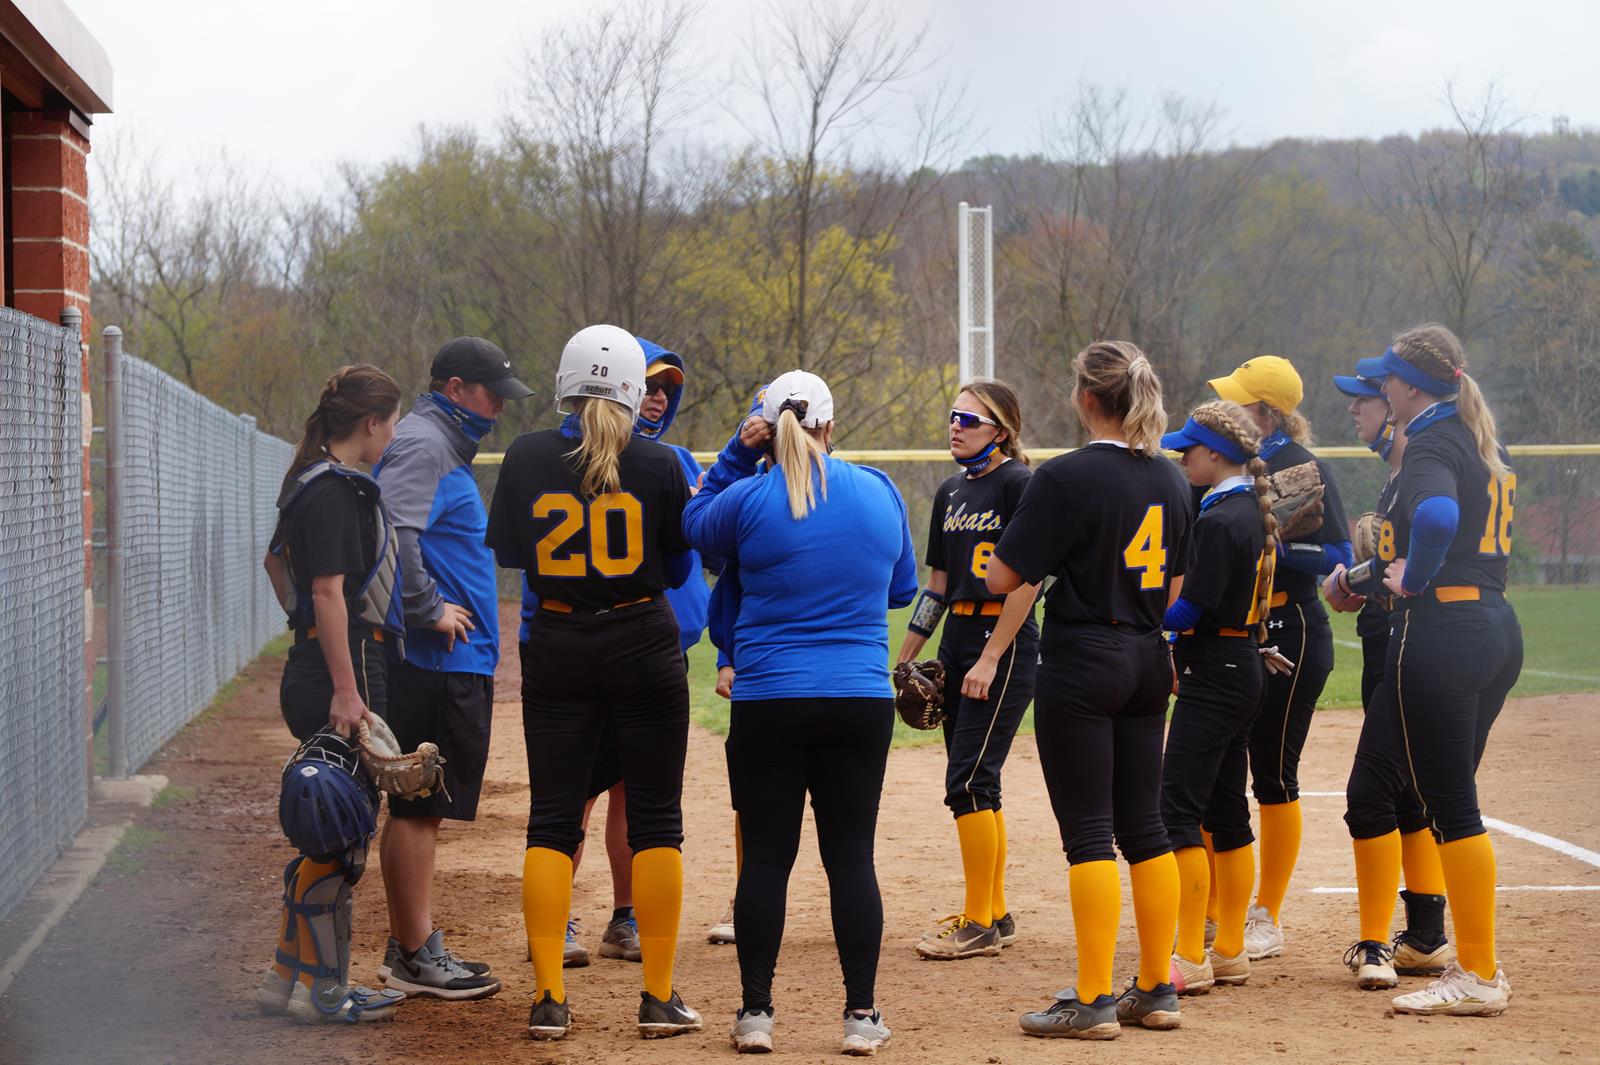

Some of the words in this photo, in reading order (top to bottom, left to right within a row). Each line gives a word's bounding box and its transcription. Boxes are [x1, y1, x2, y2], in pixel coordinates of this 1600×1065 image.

[591, 364, 608, 378] 20
[531, 491, 644, 578] 20
[1122, 503, 1168, 591] 4
[1377, 519, 1397, 562] 8
